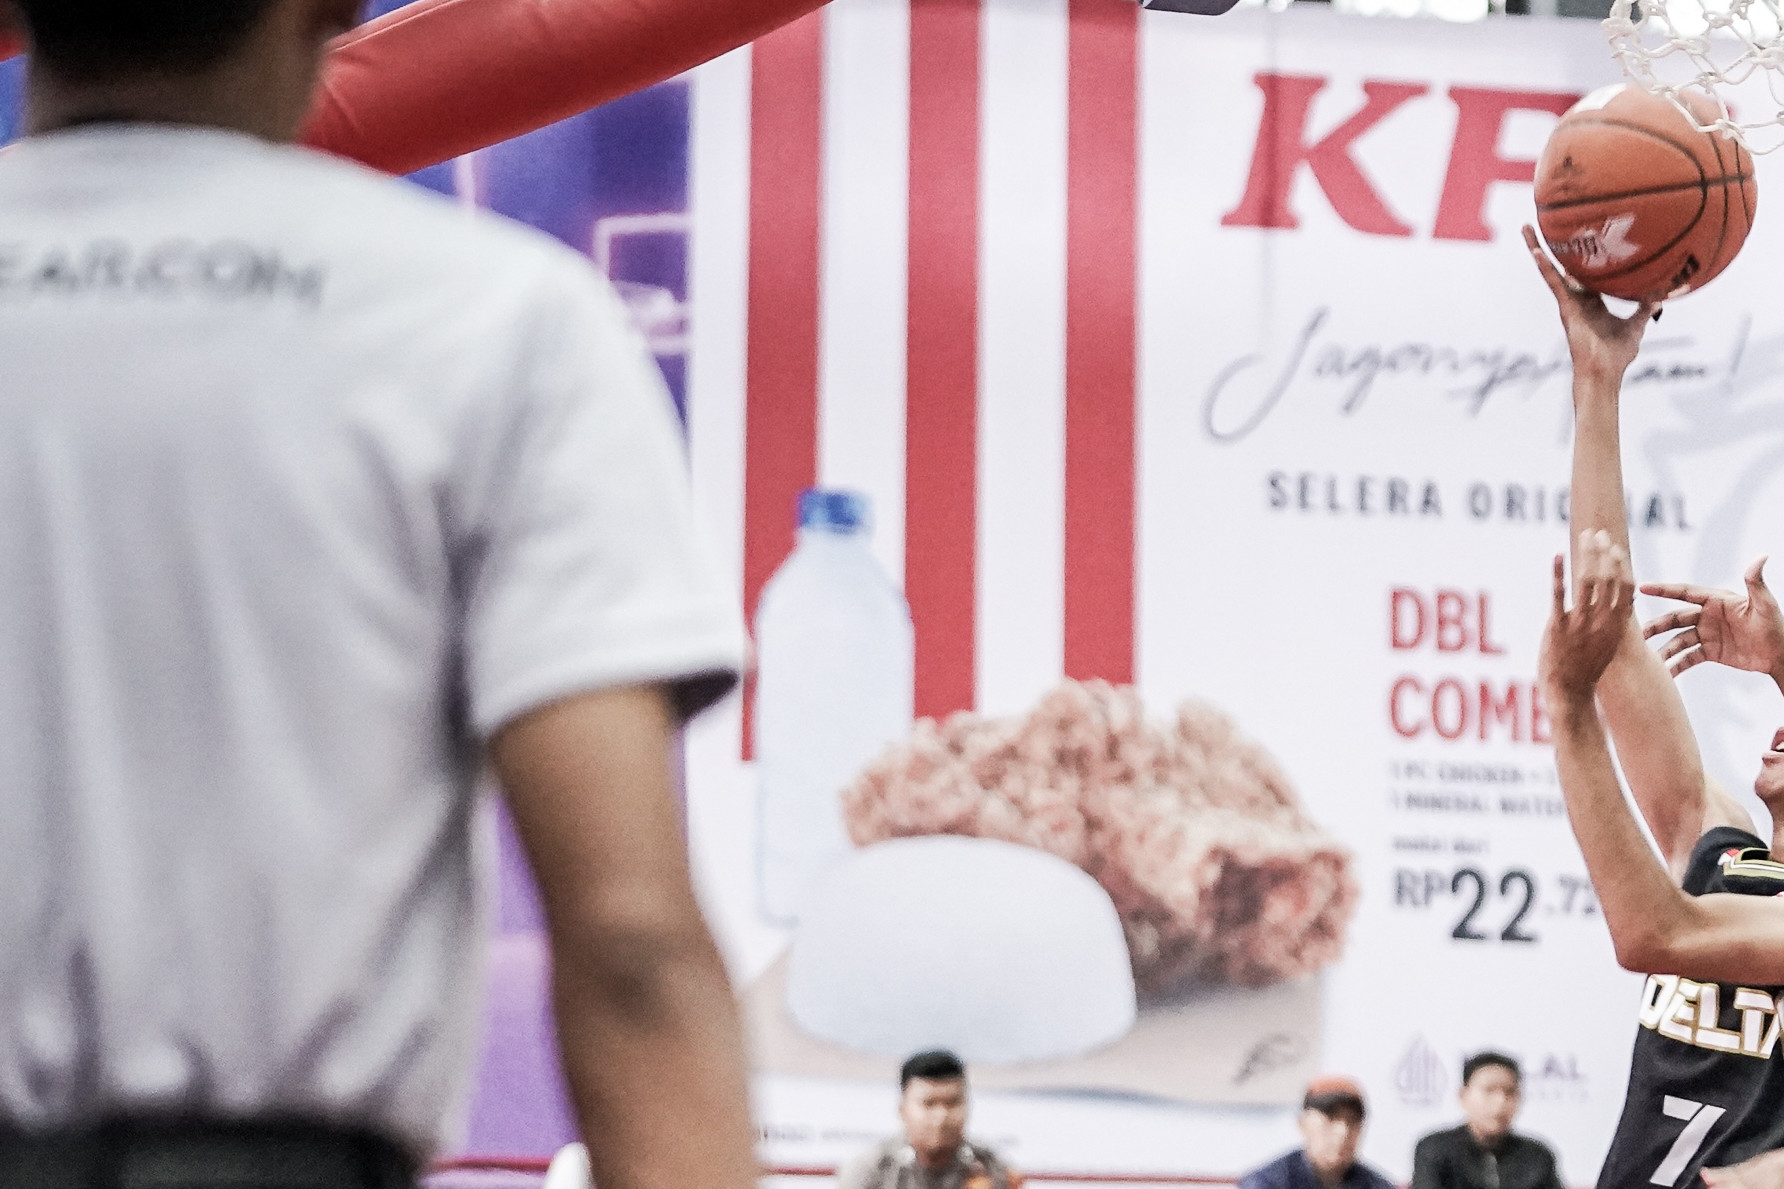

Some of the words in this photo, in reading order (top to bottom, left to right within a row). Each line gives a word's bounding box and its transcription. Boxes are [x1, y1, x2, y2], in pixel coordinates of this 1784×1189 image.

[1220, 70, 1592, 243] KF
[1268, 471, 1443, 518] SELERA
[1391, 588, 1507, 653] DBL
[1649, 1094, 1727, 1188] 7
